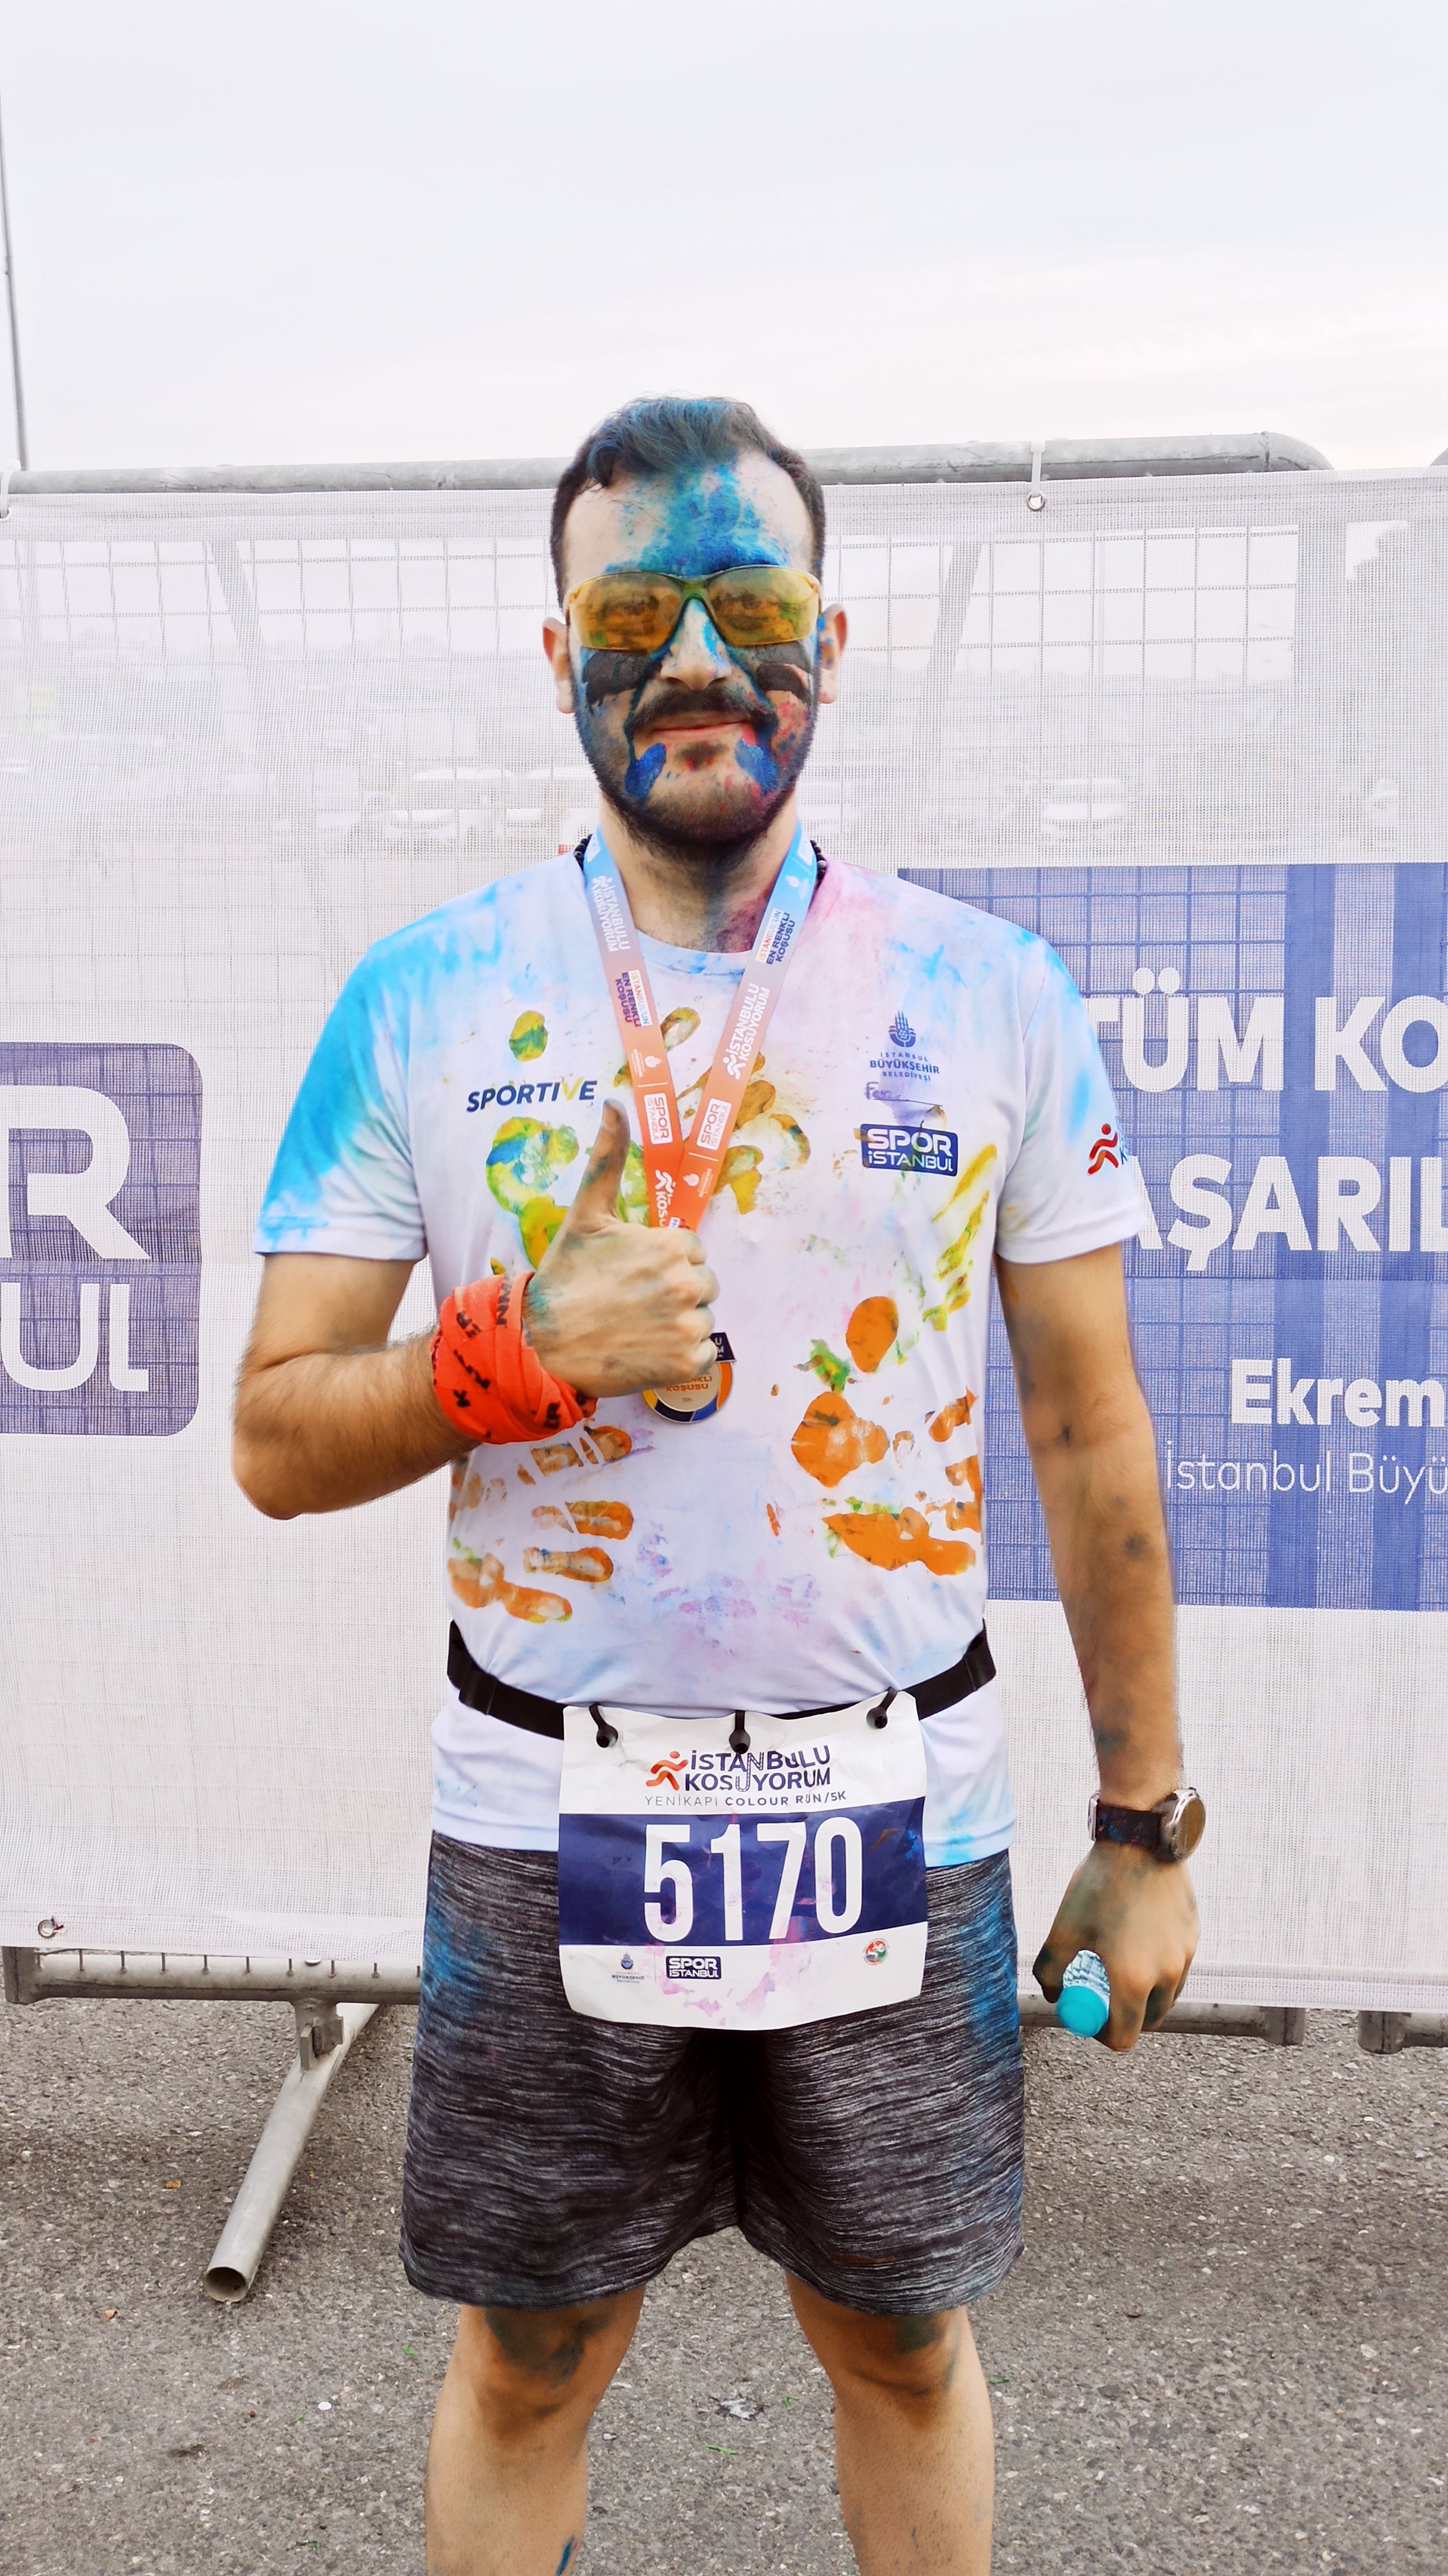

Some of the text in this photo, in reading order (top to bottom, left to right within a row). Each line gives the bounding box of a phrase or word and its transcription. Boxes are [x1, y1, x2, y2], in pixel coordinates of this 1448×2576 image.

[766, 950, 776, 965] EN
[775, 919, 795, 962] KOŞUSU
[622, 972, 631, 987] EN
[615, 978, 633, 1023] KOŞUSU
[466, 1077, 598, 1113] SPORTIVE
[654, 1097, 669, 1138] SPOR
[701, 1103, 721, 1144] SPOR
[867, 1128, 953, 1157] SPOR
[868, 1151, 953, 1172] İSTANBUL
[1230, 1358, 1445, 1428] Ekrem
[1166, 1440, 1448, 1505] İstanbul Büyü
[645, 1793, 718, 1807] YENİKAPI
[725, 1796, 789, 1806] COLOUR
[644, 1816, 863, 1943] 5170
[669, 1957, 718, 1970] SPOR
